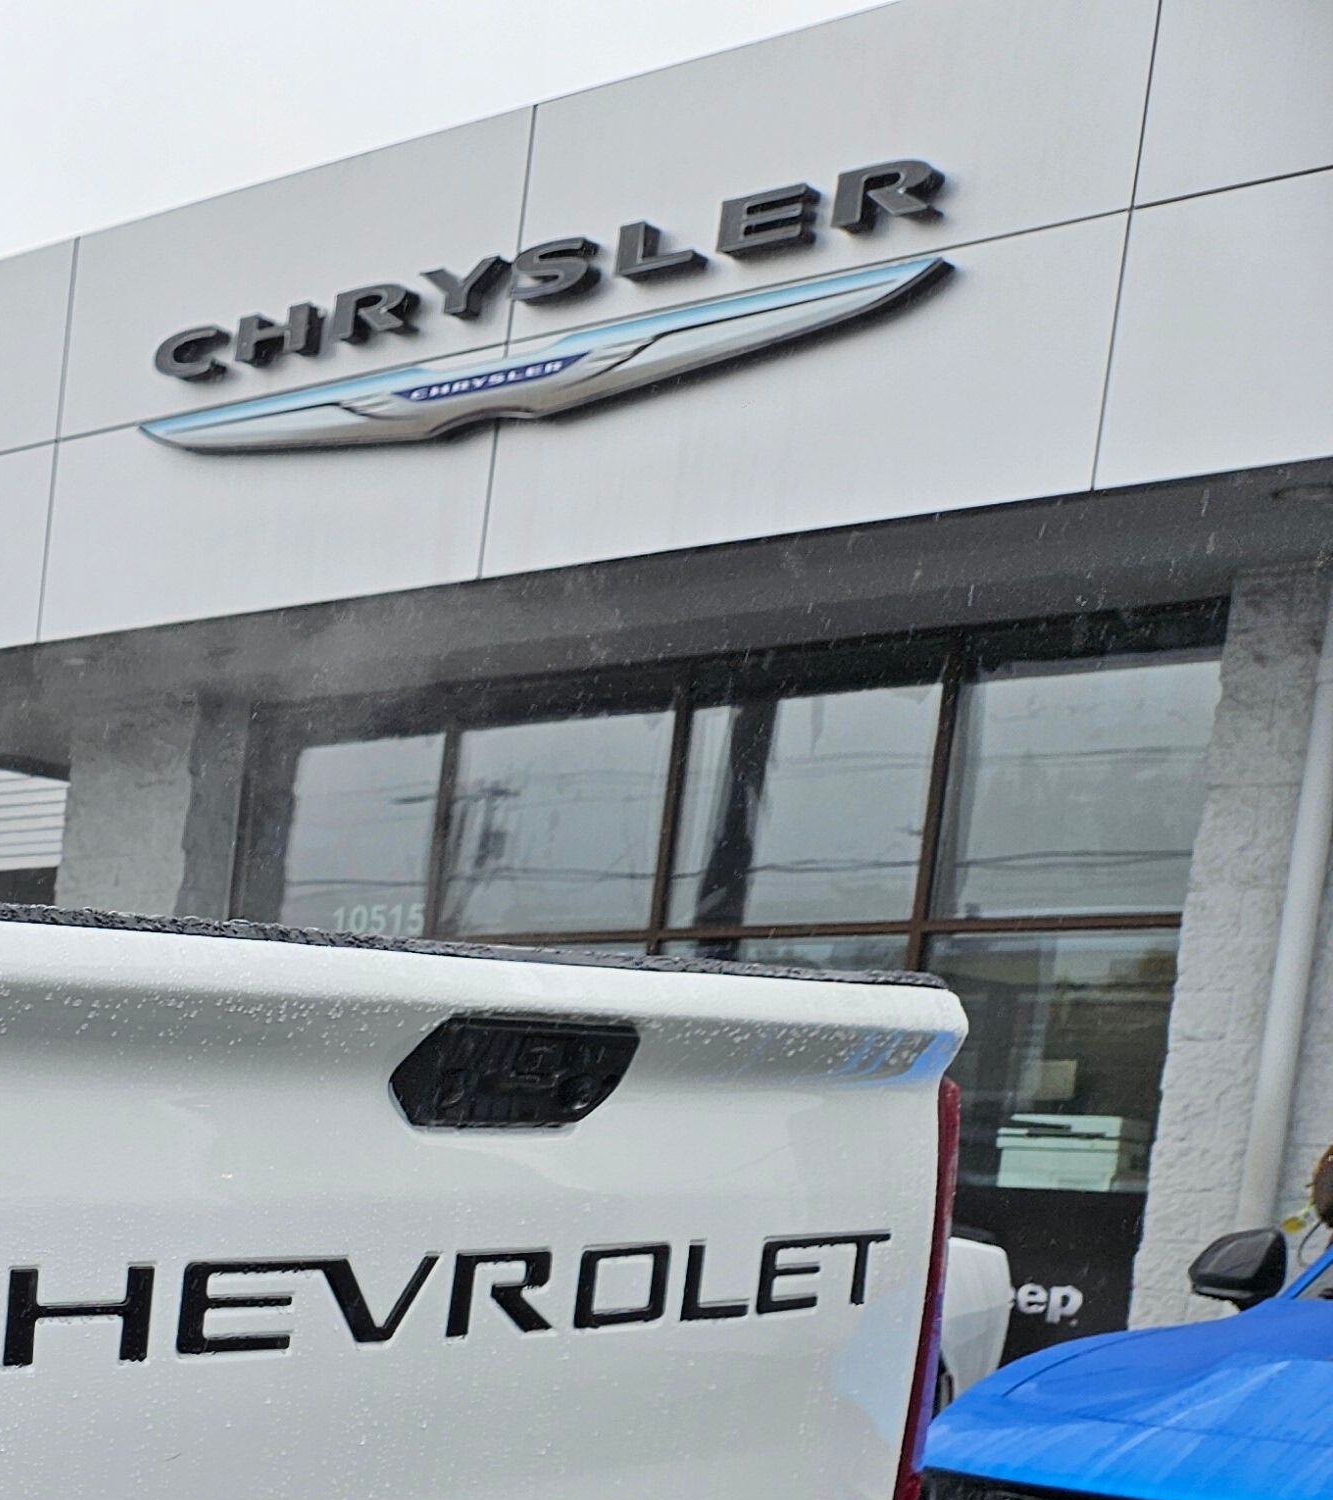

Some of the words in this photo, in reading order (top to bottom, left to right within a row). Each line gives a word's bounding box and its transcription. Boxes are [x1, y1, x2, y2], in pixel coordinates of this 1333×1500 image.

[154, 160, 947, 381] CHRYSLER
[410, 361, 563, 399] CHRYSLER
[332, 904, 425, 936] 10515
[1008, 1282, 1083, 1324] ep
